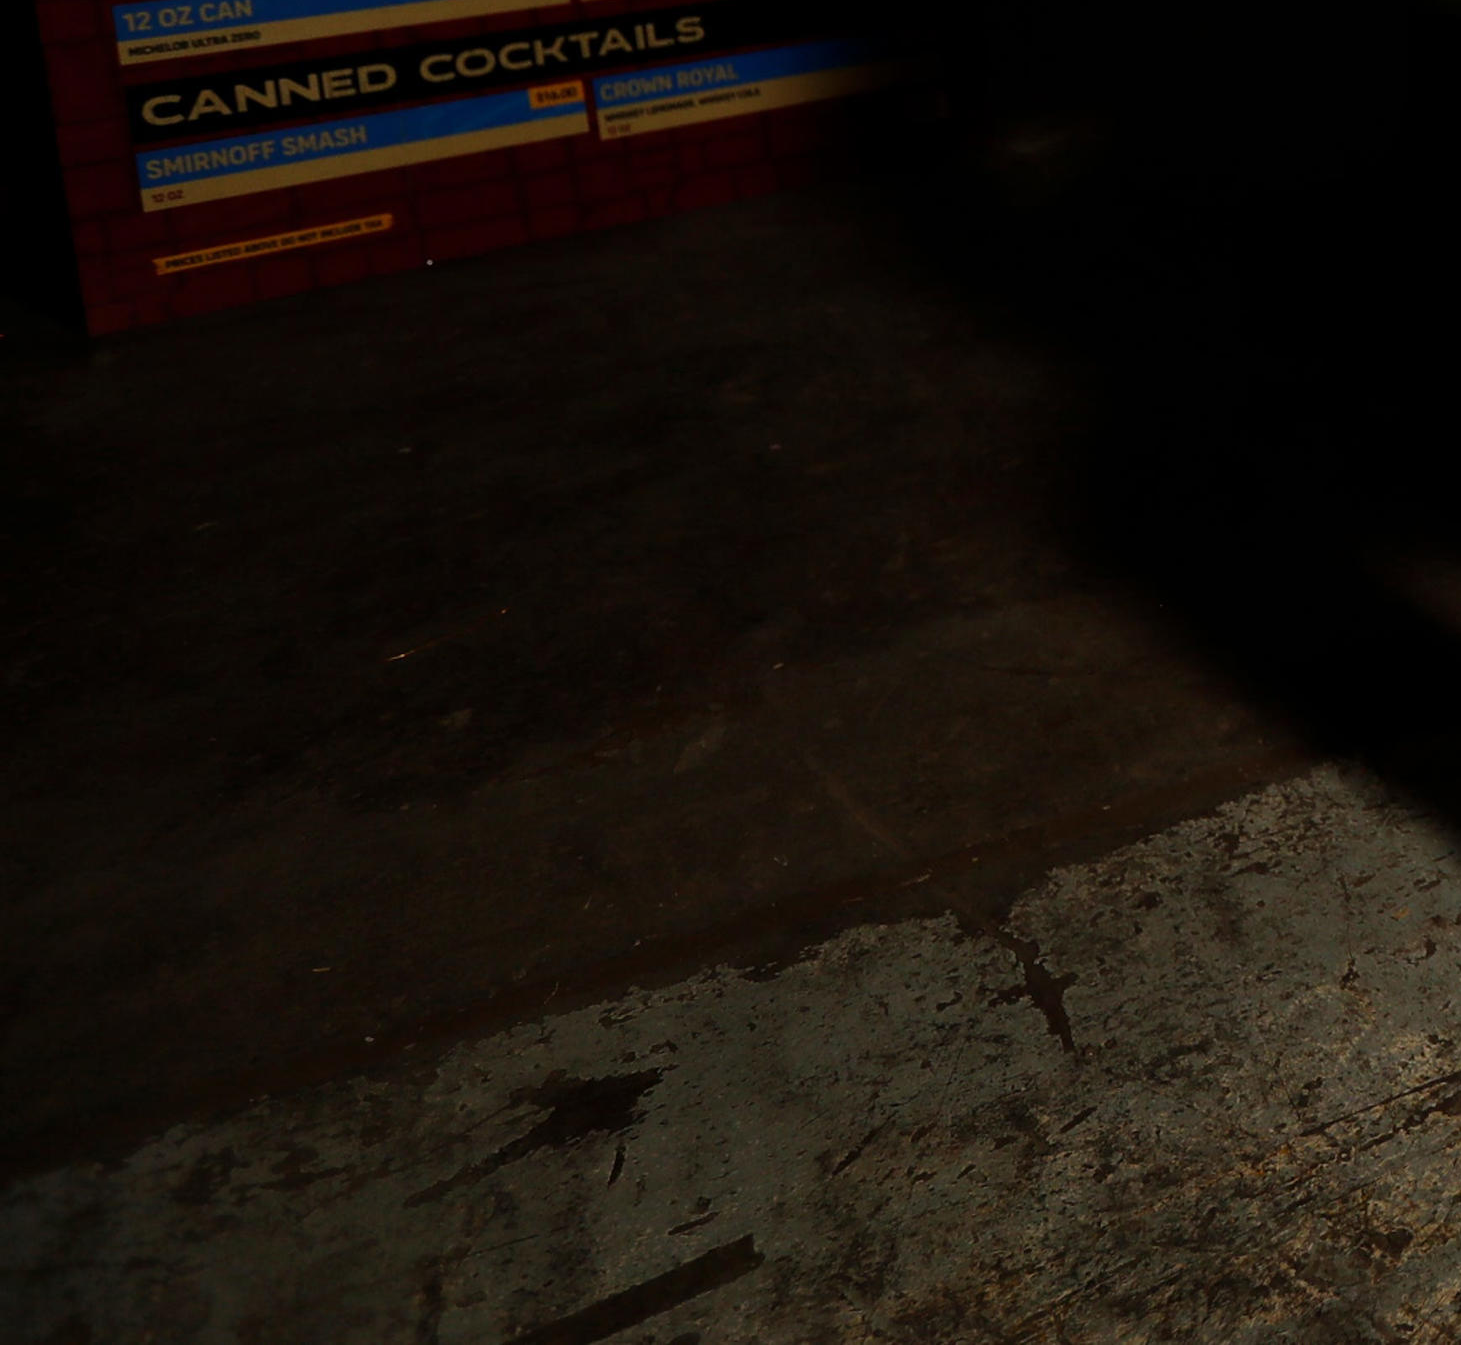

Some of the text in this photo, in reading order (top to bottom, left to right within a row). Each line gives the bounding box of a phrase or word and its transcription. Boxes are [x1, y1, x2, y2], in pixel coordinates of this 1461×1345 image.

[123, 11, 154, 33] 12
[157, 7, 195, 29] OZ
[190, 34, 228, 51] ULTRA
[230, 30, 261, 44] ZERO
[140, 14, 706, 128] CANNED COCKTAILS
[599, 63, 739, 102] CROWN ROYAL
[144, 125, 369, 182] SMIRNOFF SMASH
